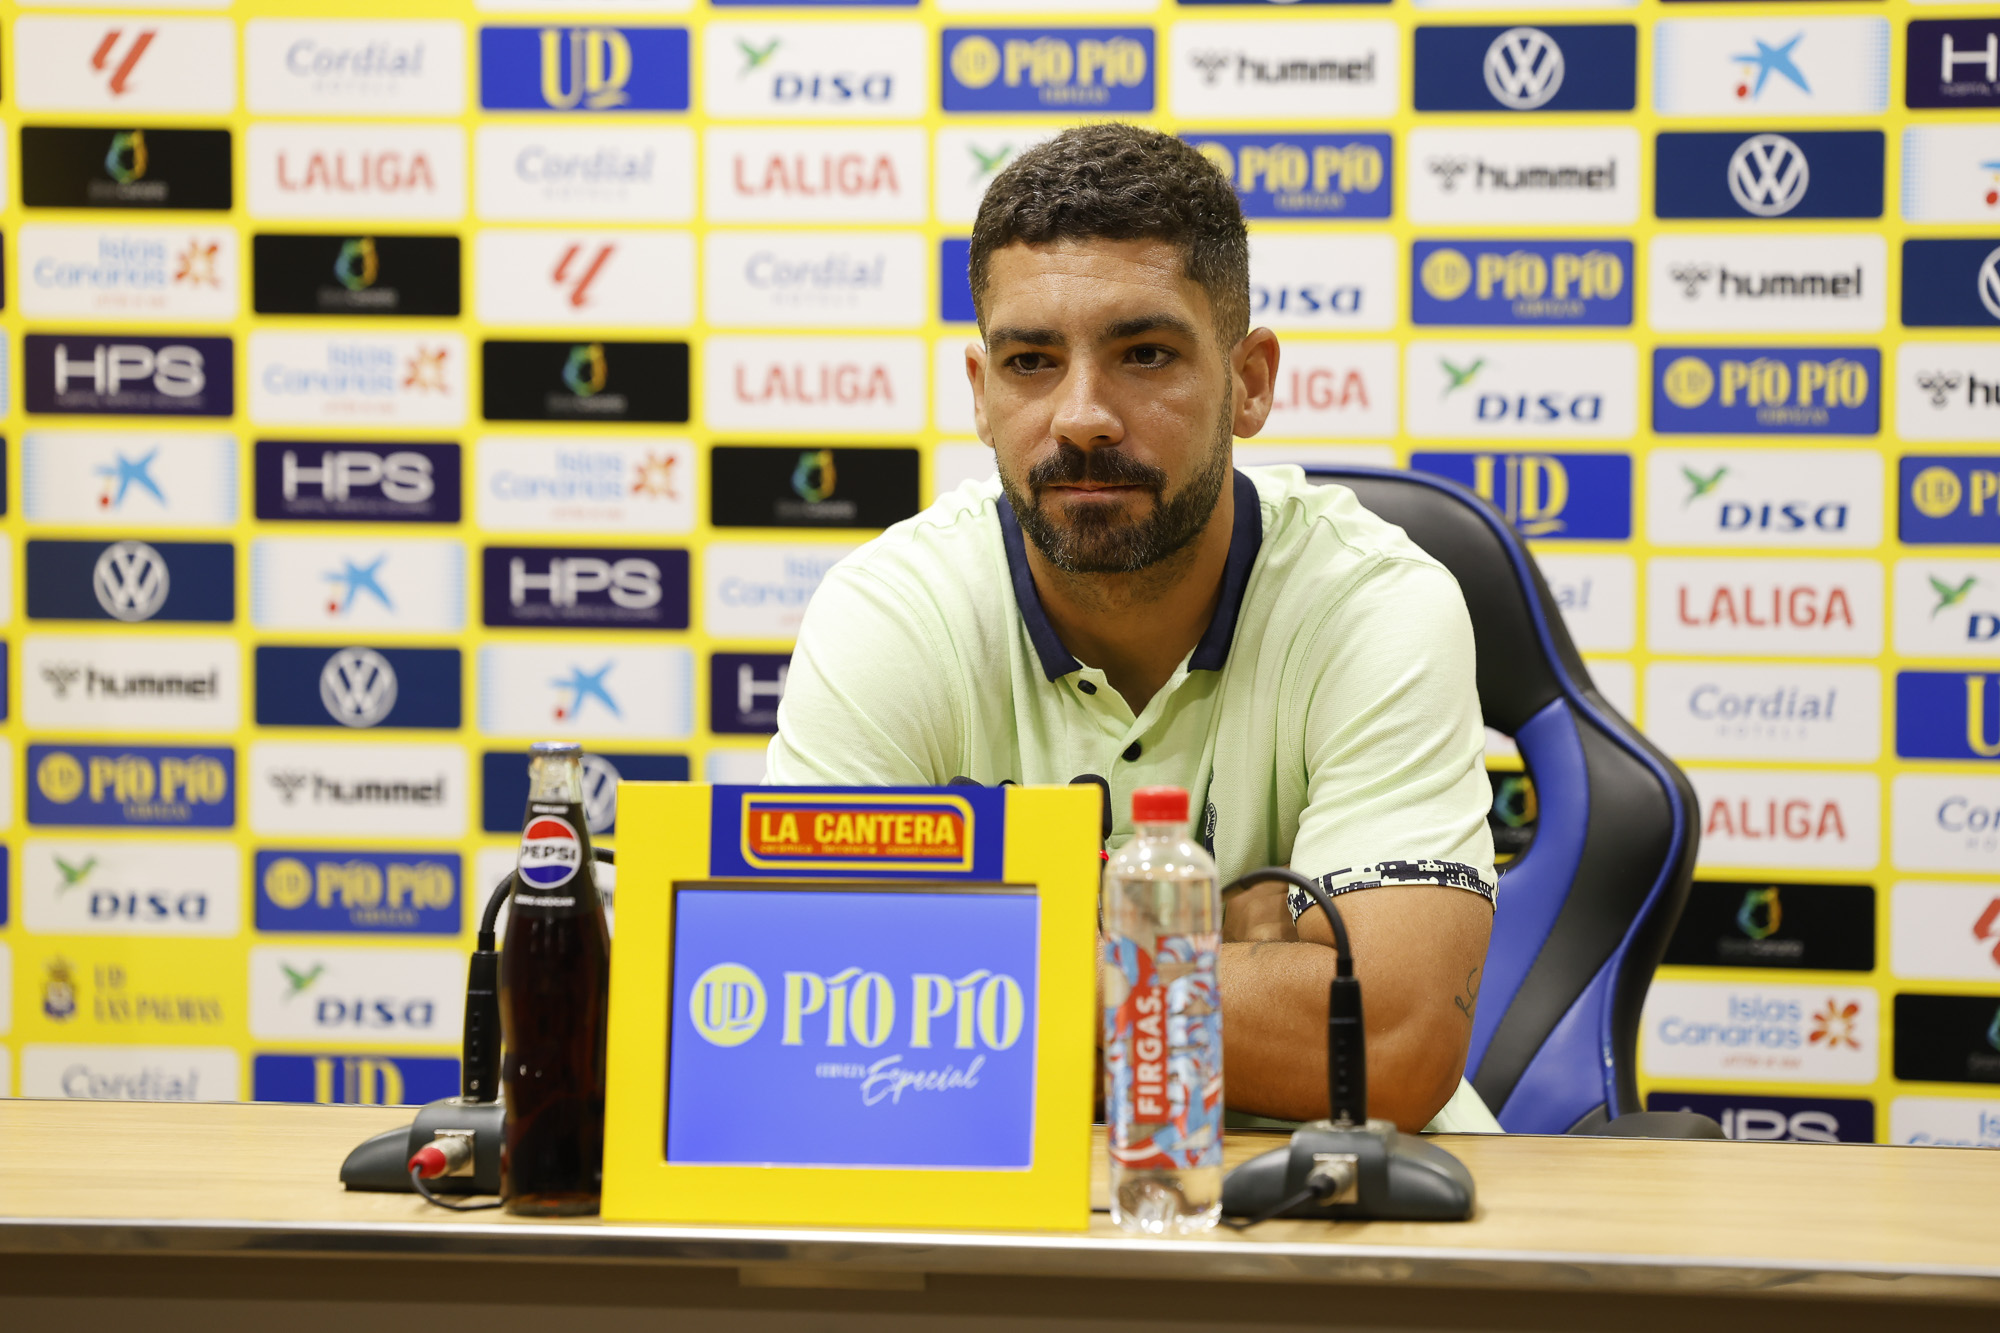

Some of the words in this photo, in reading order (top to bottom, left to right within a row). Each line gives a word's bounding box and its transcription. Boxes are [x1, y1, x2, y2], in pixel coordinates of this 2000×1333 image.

[285, 38, 425, 78] Cordial
[539, 28, 632, 109] UD
[1237, 53, 1376, 85] hummel
[276, 150, 435, 193] LALIGA
[733, 153, 899, 197] LALIGA
[1475, 156, 1617, 191] hummel
[1718, 264, 1863, 299] hummel
[54, 344, 206, 396] HPS
[734, 363, 895, 405] LALIGA
[283, 450, 434, 503] HPS
[510, 556, 662, 609] HPS
[1678, 585, 1854, 628] LALIGA
[86, 667, 218, 698] hummel
[1688, 684, 1836, 721] Cordial
[312, 772, 445, 805] hummel
[760, 813, 799, 843] LA
[814, 813, 957, 845] CANTERA
[1706, 798, 1847, 840] ALIGA
[521, 844, 577, 862] PEPSI
[861, 1053, 986, 1107] Especial
